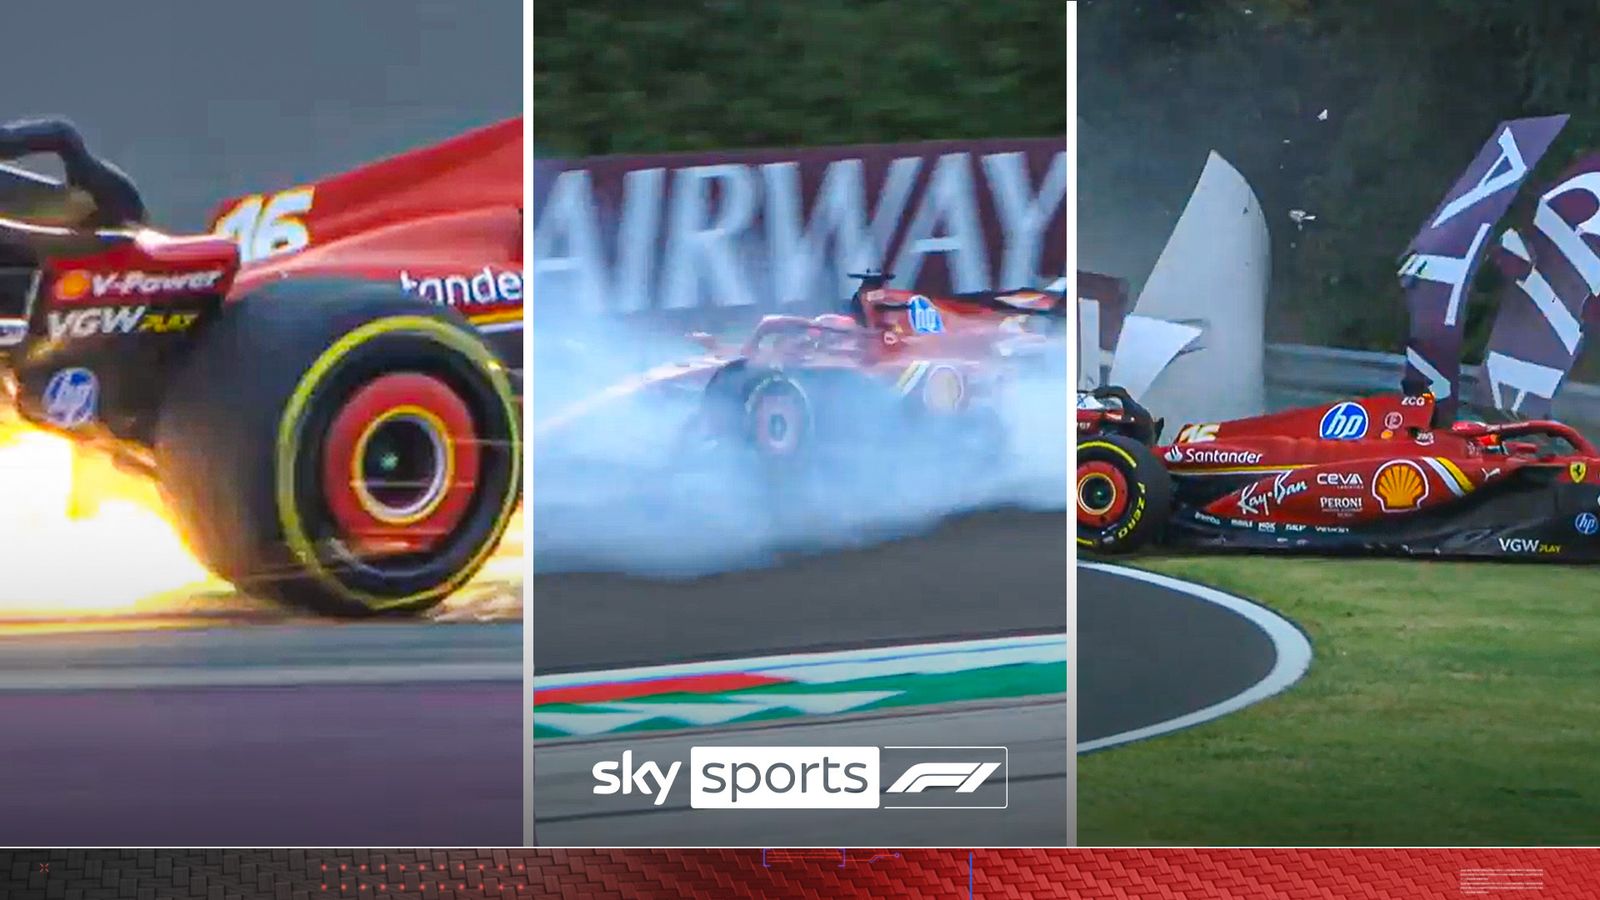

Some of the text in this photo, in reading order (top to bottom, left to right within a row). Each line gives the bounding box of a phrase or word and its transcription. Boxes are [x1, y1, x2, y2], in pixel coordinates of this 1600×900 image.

[213, 186, 316, 263] 16
[92, 269, 225, 297] V-Power
[400, 265, 523, 305] tande
[47, 306, 146, 338] VGW
[1324, 402, 1364, 438] hp
[1185, 447, 1264, 464] Santander
[1320, 497, 1362, 508] PERONI
[1577, 513, 1596, 534] hp
[1498, 537, 1561, 553] VGW PLAY
